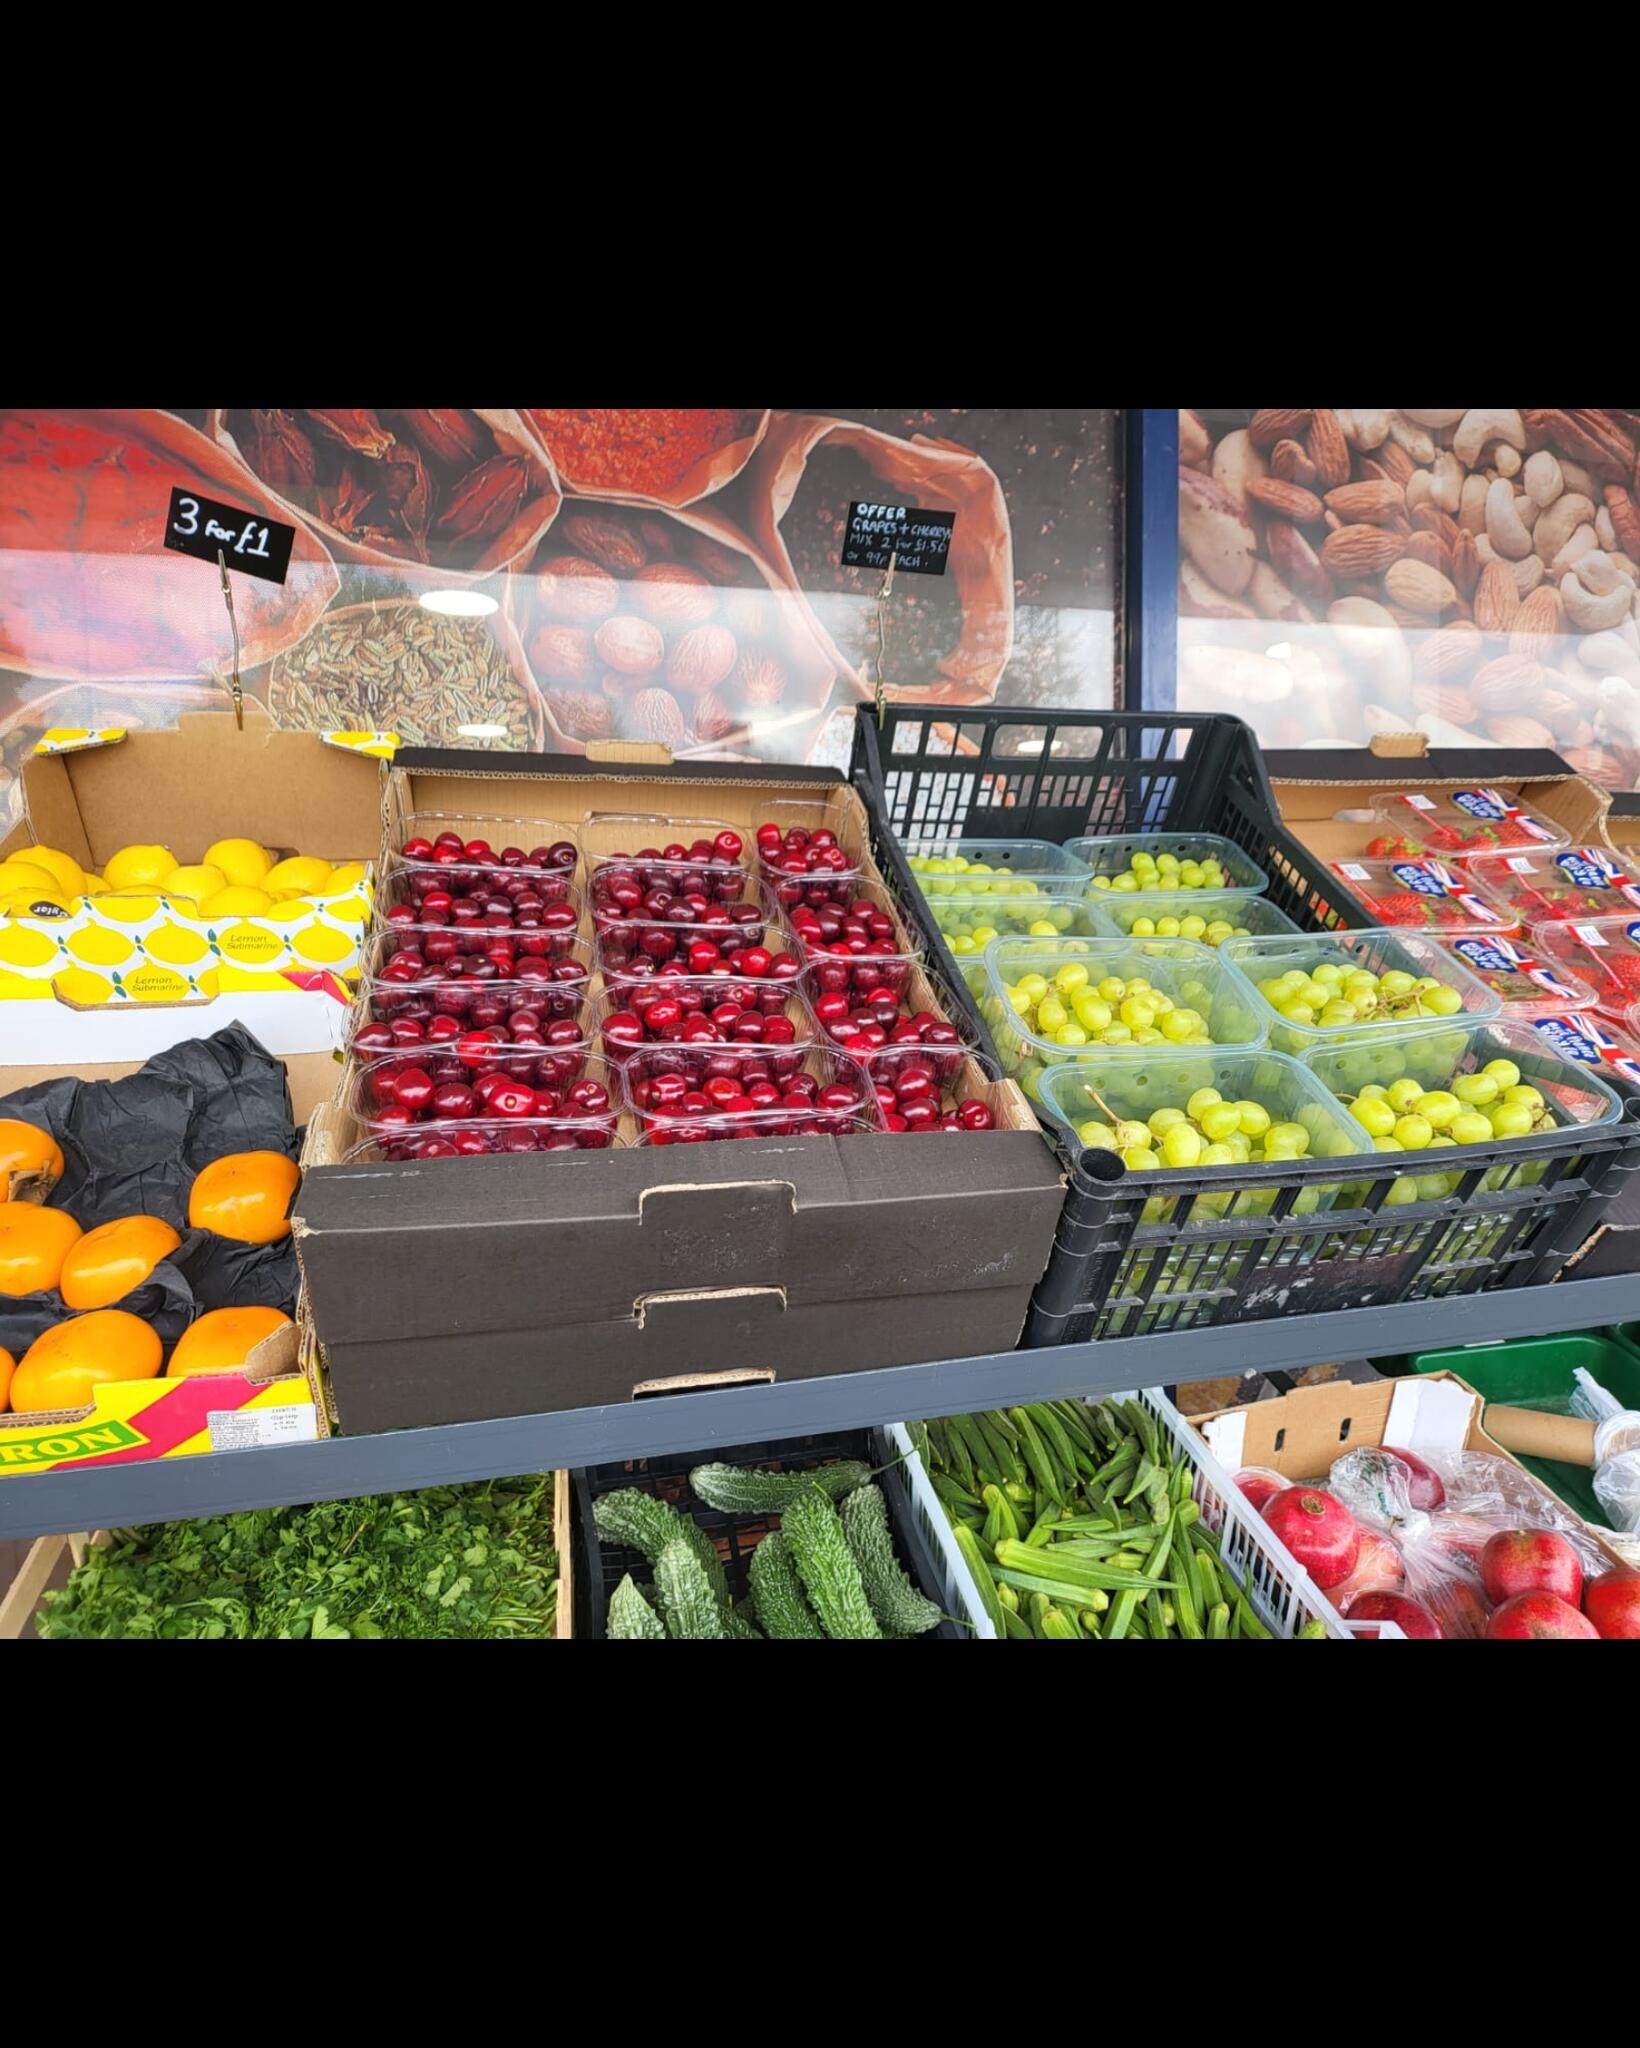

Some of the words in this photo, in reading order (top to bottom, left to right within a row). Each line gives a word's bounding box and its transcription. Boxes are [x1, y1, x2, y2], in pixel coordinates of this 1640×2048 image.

[857, 503, 906, 520] OFFER
[173, 498, 199, 535] 3
[233, 521, 270, 557] £1
[852, 517, 897, 534] GRAPES
[849, 533, 874, 546] MIX
[880, 537, 891, 549] 2
[230, 934, 267, 942] Lemon
[227, 942, 278, 950] Submarine
[135, 976, 172, 984] Lemon
[132, 984, 184, 992] Submarine
